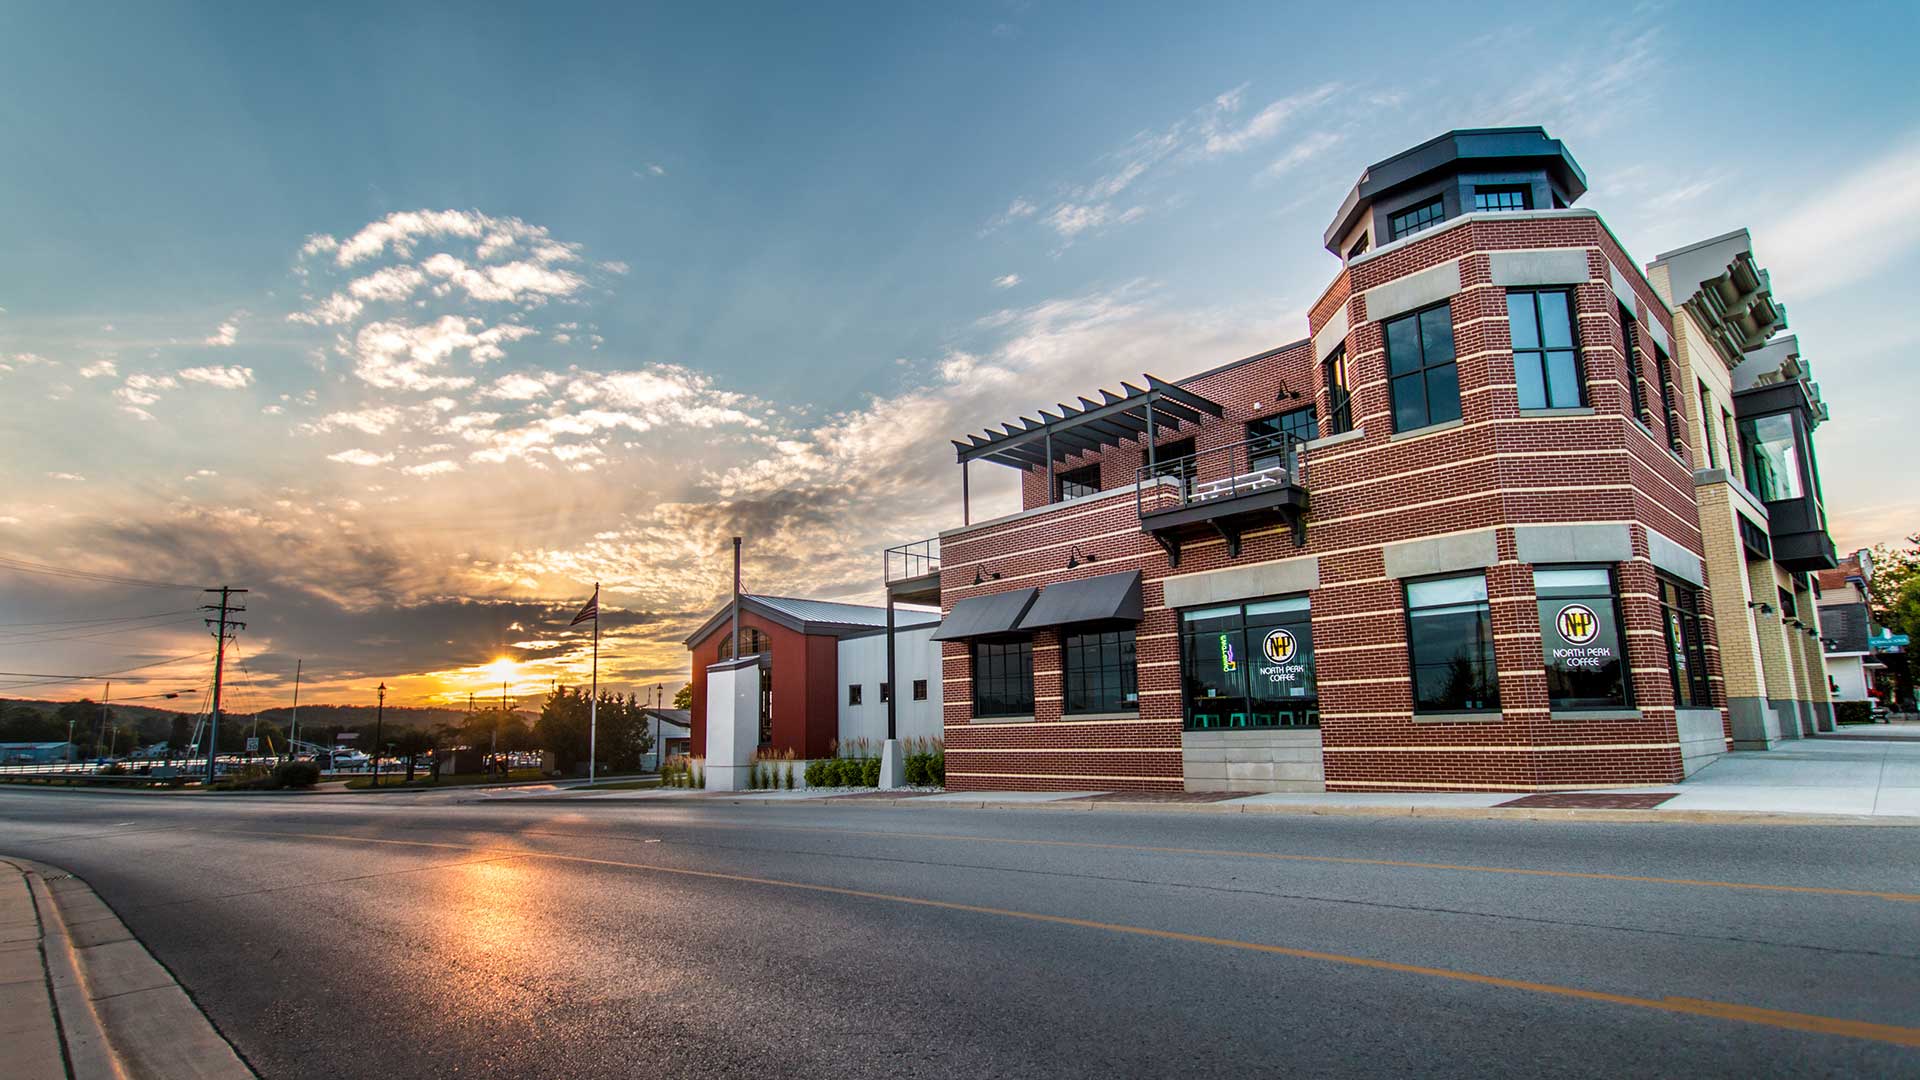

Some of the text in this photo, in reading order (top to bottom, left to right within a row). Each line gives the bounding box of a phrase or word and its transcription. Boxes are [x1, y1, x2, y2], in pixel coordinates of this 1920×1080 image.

[1552, 647, 1585, 658] NORTH
[1566, 657, 1600, 666] COFFEE
[1260, 666, 1285, 675] NORTH
[1269, 673, 1295, 682] COFFEE
